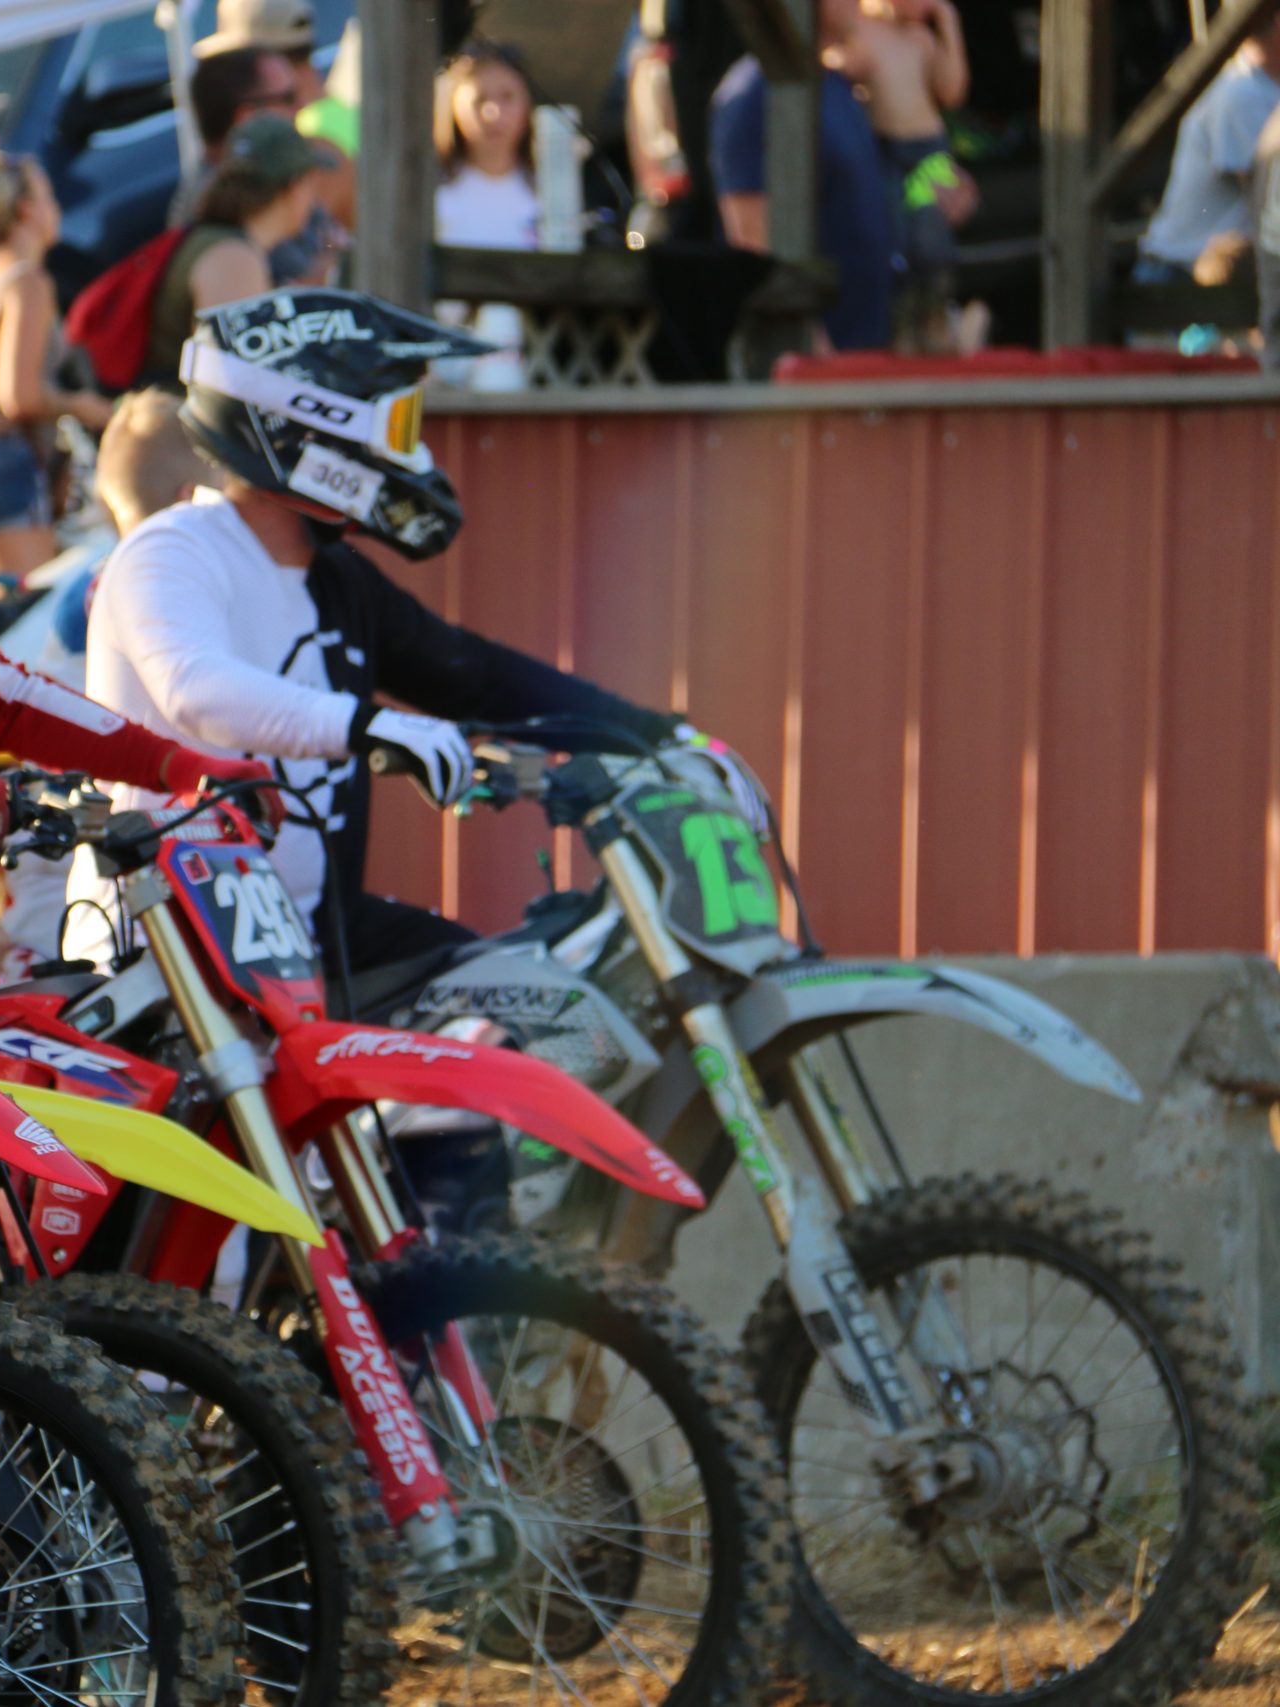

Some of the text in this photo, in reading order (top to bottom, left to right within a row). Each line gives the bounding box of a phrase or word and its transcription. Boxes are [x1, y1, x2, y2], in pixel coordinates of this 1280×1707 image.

[679, 811, 779, 936] 13
[327, 1274, 439, 1476] DUNLOP
[335, 1344, 417, 1486] ACERBIS
